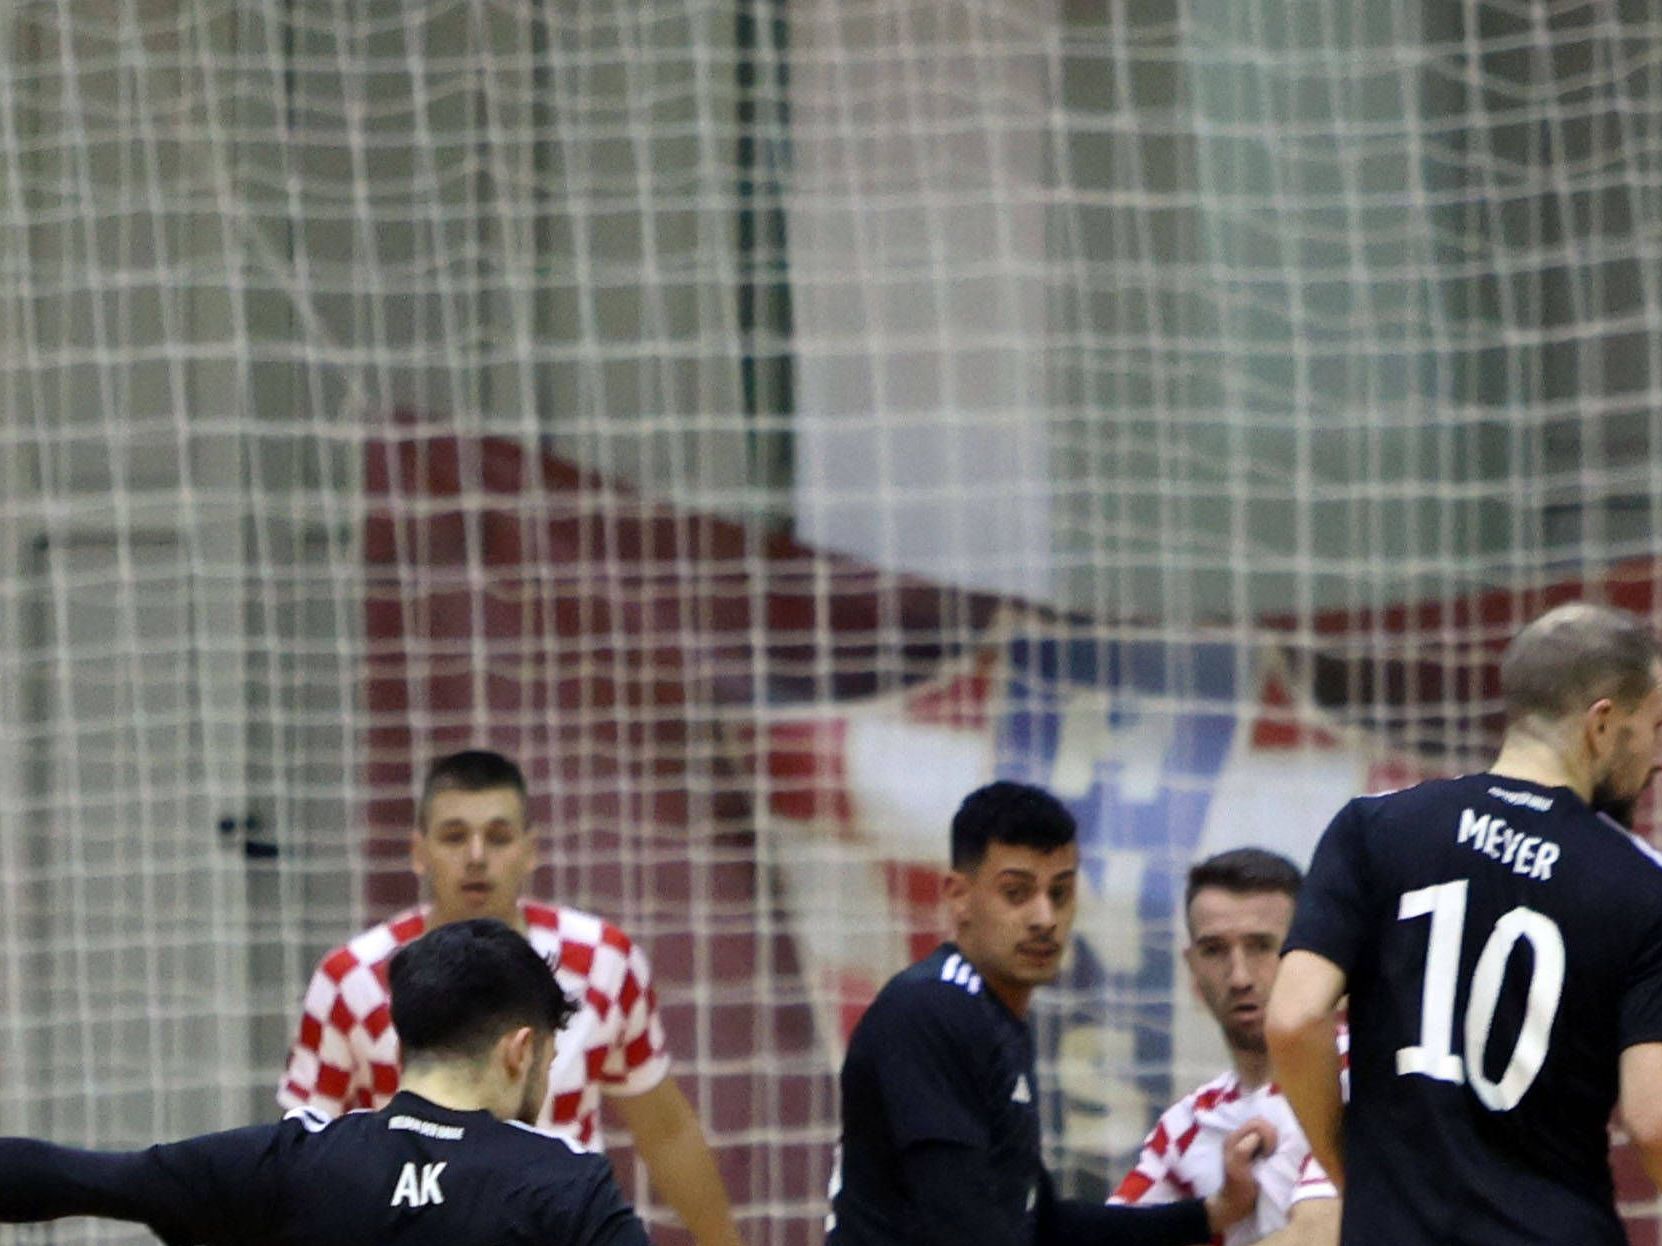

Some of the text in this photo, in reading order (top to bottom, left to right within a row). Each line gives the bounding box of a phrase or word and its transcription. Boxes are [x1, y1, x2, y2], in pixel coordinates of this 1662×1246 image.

[1457, 808, 1560, 881] MEYER
[1396, 879, 1566, 1111] 10
[391, 1162, 447, 1207] AK
